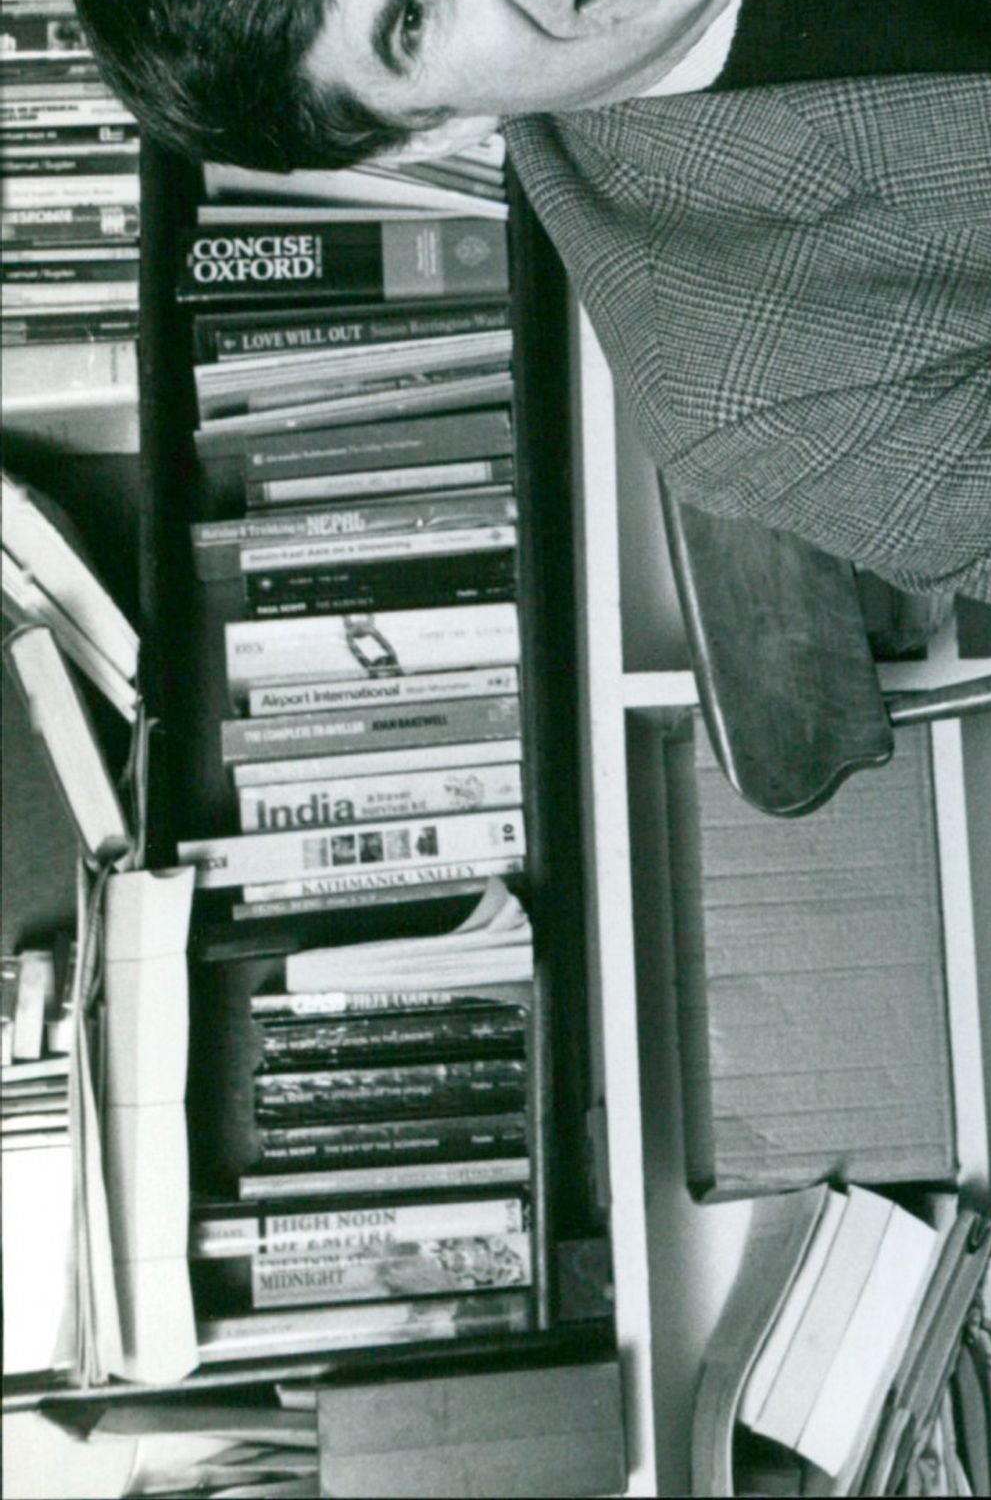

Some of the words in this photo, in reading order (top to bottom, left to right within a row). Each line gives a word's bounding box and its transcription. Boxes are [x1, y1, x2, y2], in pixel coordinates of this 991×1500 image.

[193, 235, 313, 260] CONCISE
[194, 256, 315, 283] OXFORD
[242, 330, 284, 350] LOVE
[286, 327, 328, 346] WILL
[328, 323, 363, 342] OUT
[306, 511, 366, 536] NEPAL
[261, 692, 311, 709] Airport
[313, 684, 401, 703] International
[263, 725, 311, 742] COMPLETE
[372, 718, 399, 732] JOAN
[400, 715, 448, 730] BAKEWELL
[257, 793, 355, 829] India
[301, 875, 412, 897] KATHMANDU
[417, 865, 477, 882] VALLEY
[272, 1213, 330, 1234] HIGH
[337, 1209, 396, 1228] NOON
[260, 1270, 346, 1291] MIDNIGHT
